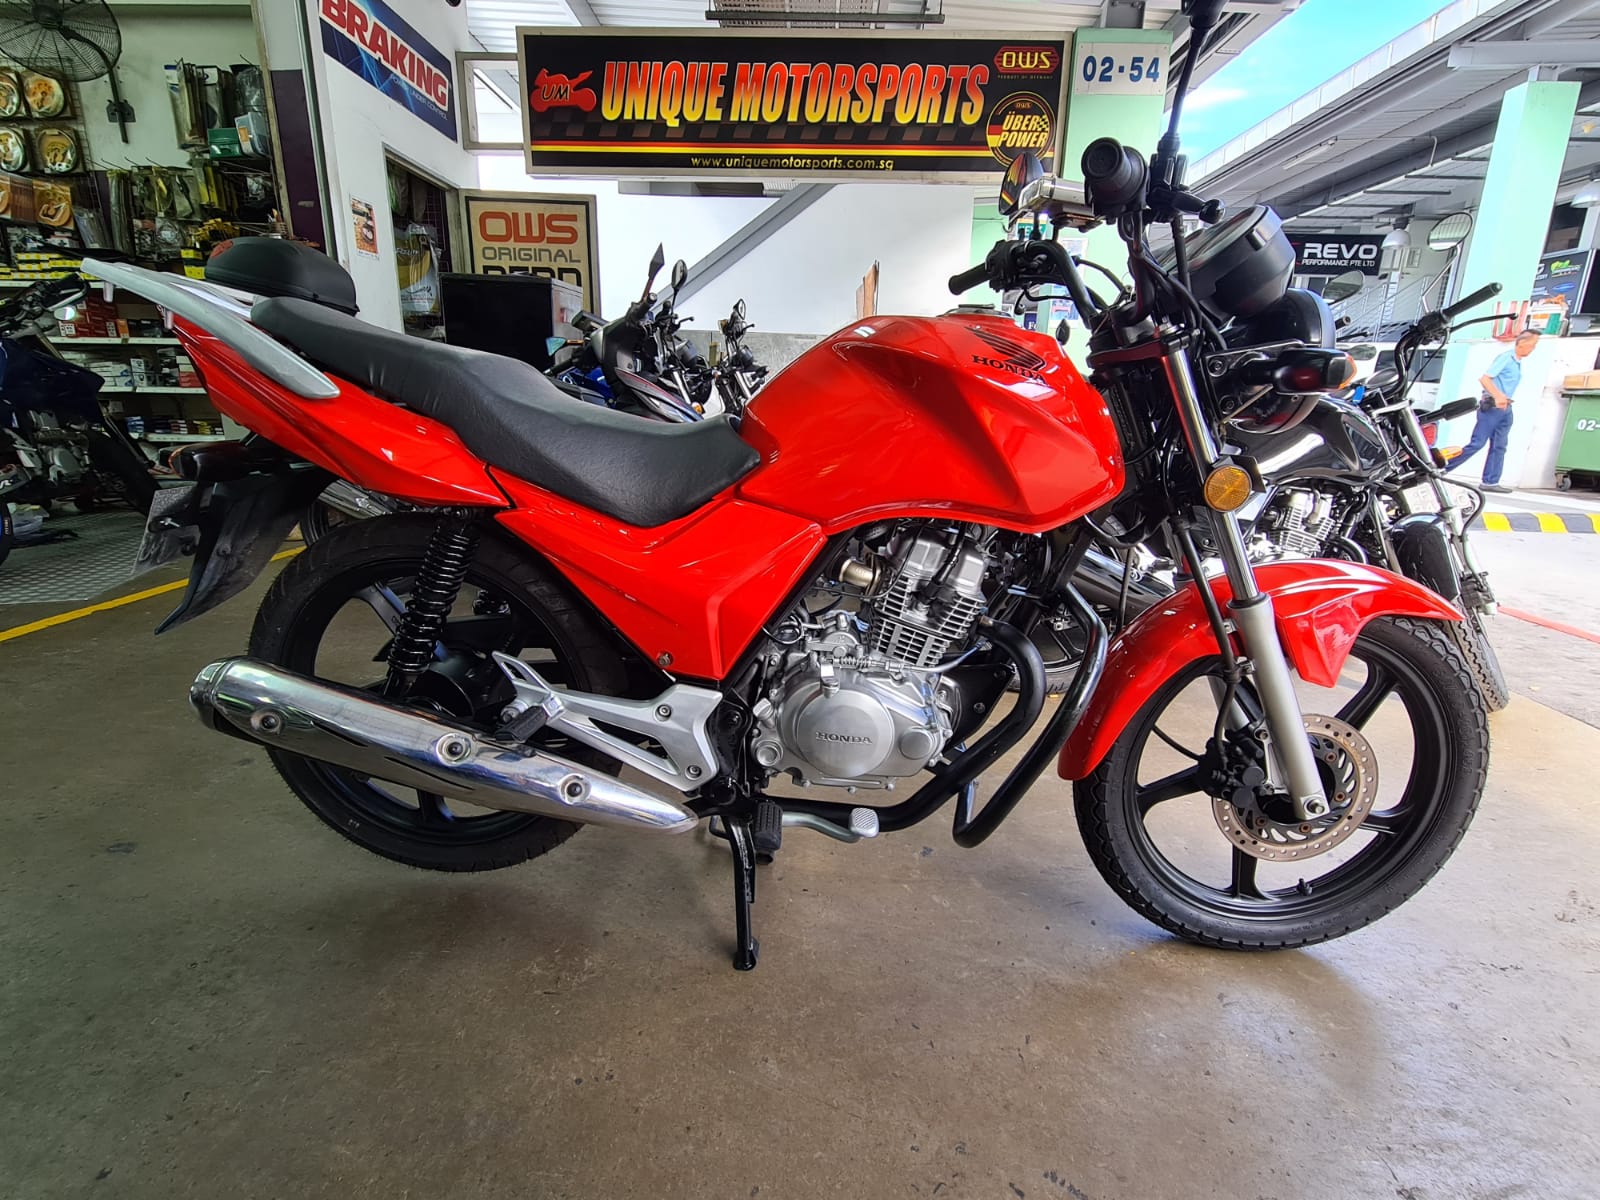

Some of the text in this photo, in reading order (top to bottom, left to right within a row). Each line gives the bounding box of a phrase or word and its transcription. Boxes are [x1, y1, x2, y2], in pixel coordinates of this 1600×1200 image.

[322, 0, 449, 108] BRAKING
[1002, 51, 1053, 69] OWS
[541, 83, 570, 101] UM
[601, 60, 991, 128] UNIQUE MOTORSPORTS
[1003, 111, 1040, 131] ÜBER
[998, 130, 1049, 148] POWER
[691, 155, 894, 171] www.uniquemotorsports.com.sg
[479, 211, 579, 245] OWS
[482, 246, 581, 263] ORIGINAL
[1303, 242, 1378, 259] REVO
[1302, 258, 1349, 267] PERFORMANCE
[971, 354, 1047, 386] HONDA
[815, 731, 873, 745] HONDA
